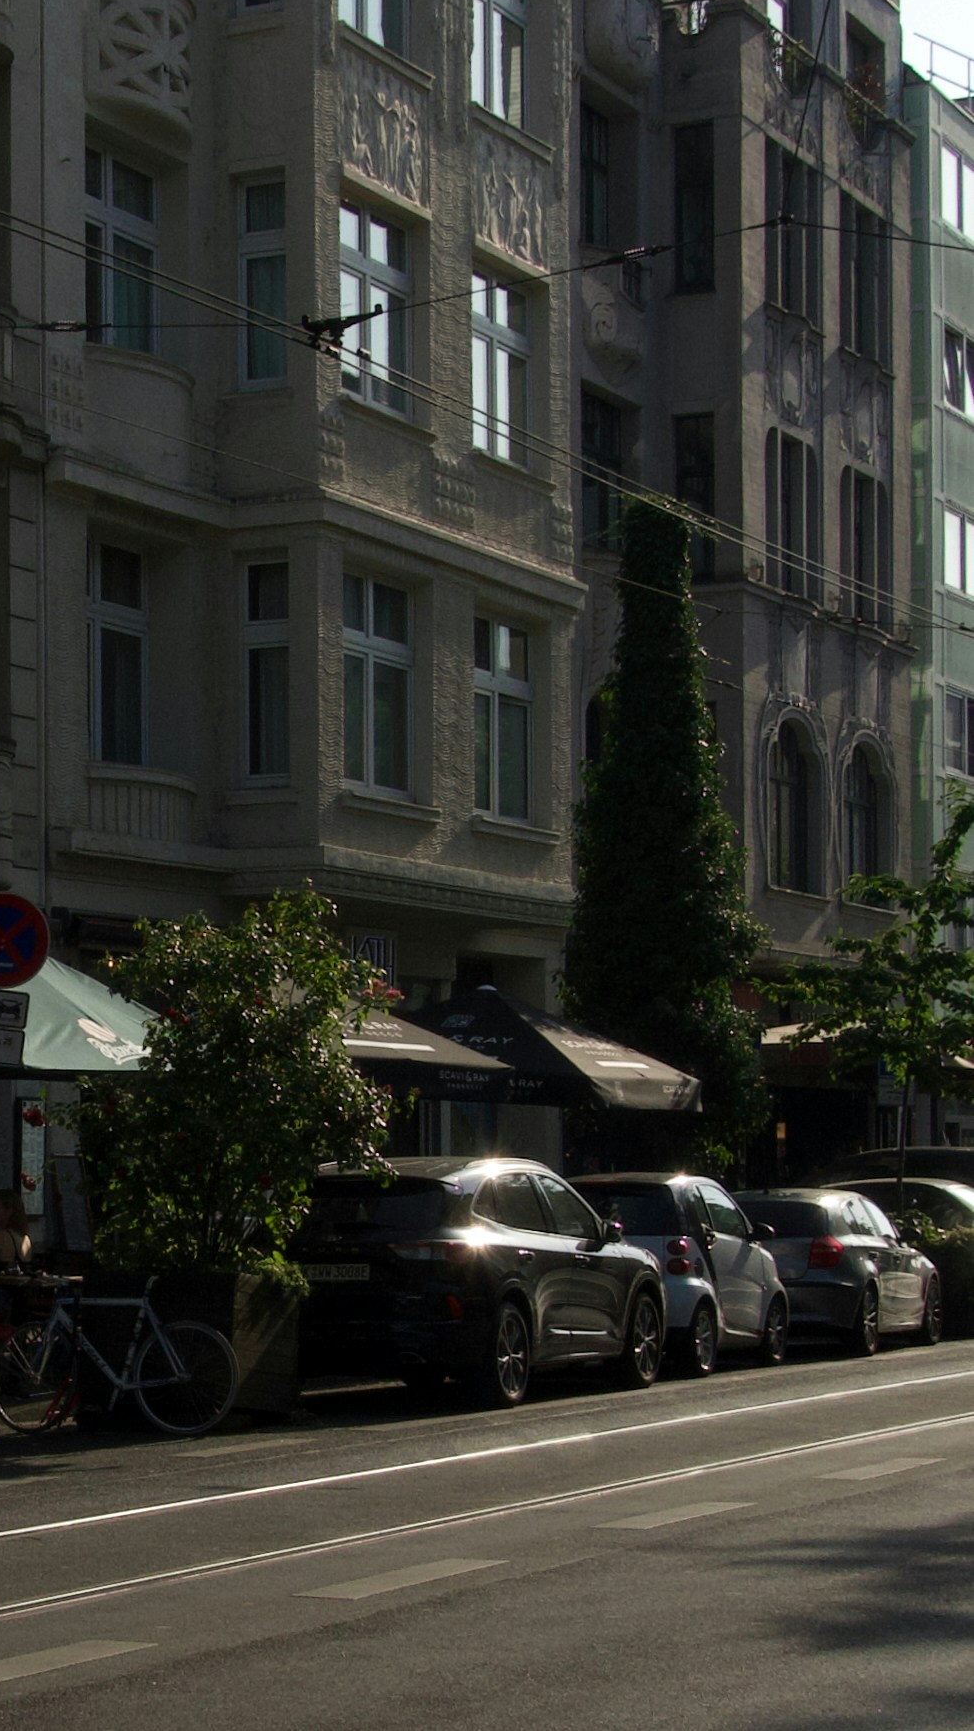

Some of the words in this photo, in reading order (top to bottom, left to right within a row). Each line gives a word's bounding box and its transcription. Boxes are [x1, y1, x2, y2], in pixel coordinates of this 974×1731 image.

[468, 1035, 514, 1045] RAY
[438, 1069, 465, 1081] SCAVI
[473, 1072, 490, 1083] RAY
[518, 1078, 544, 1089] RAY
